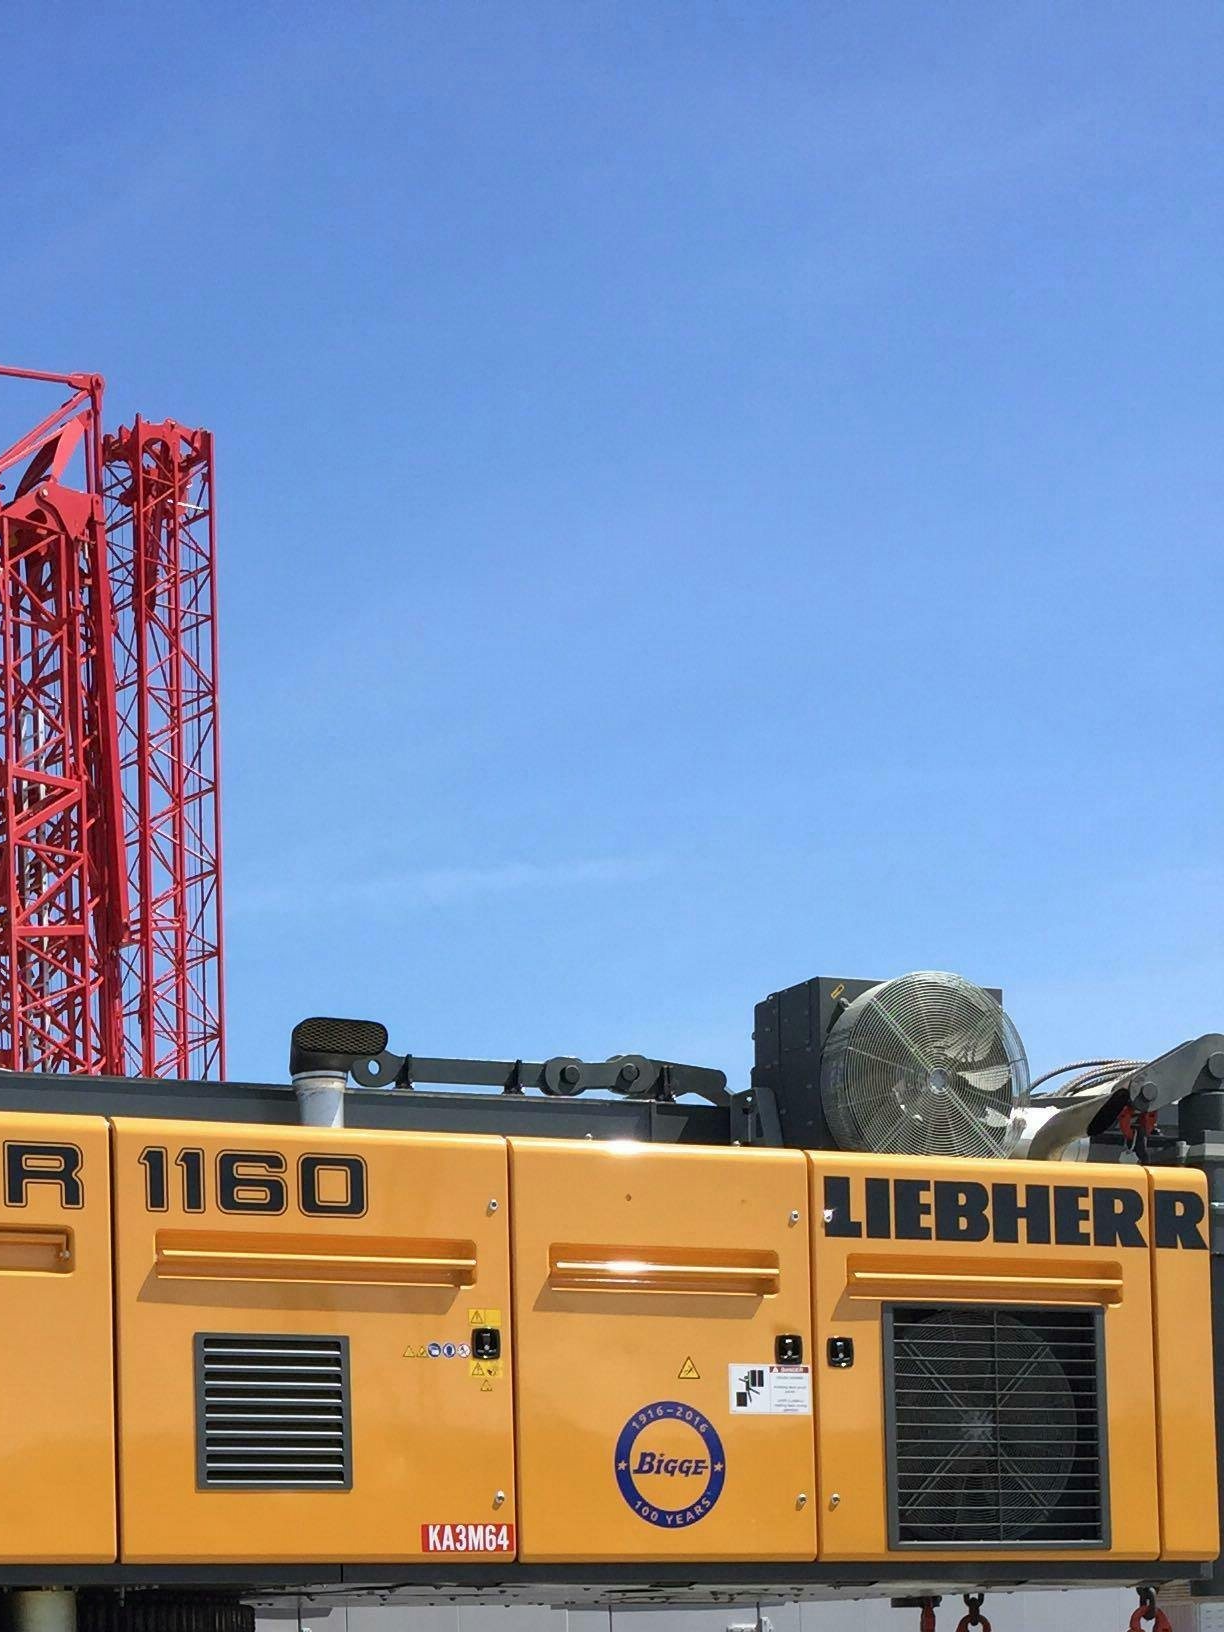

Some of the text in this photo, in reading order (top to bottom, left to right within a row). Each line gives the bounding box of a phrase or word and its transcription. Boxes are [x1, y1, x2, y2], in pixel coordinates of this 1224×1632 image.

[137, 1145, 368, 1218] 1160
[823, 1176, 1209, 1250] LIEBHERR
[632, 1406, 708, 1432] 1916-2016
[634, 1497, 711, 1524] 100 YEARS
[428, 1525, 510, 1551] KA3M64
